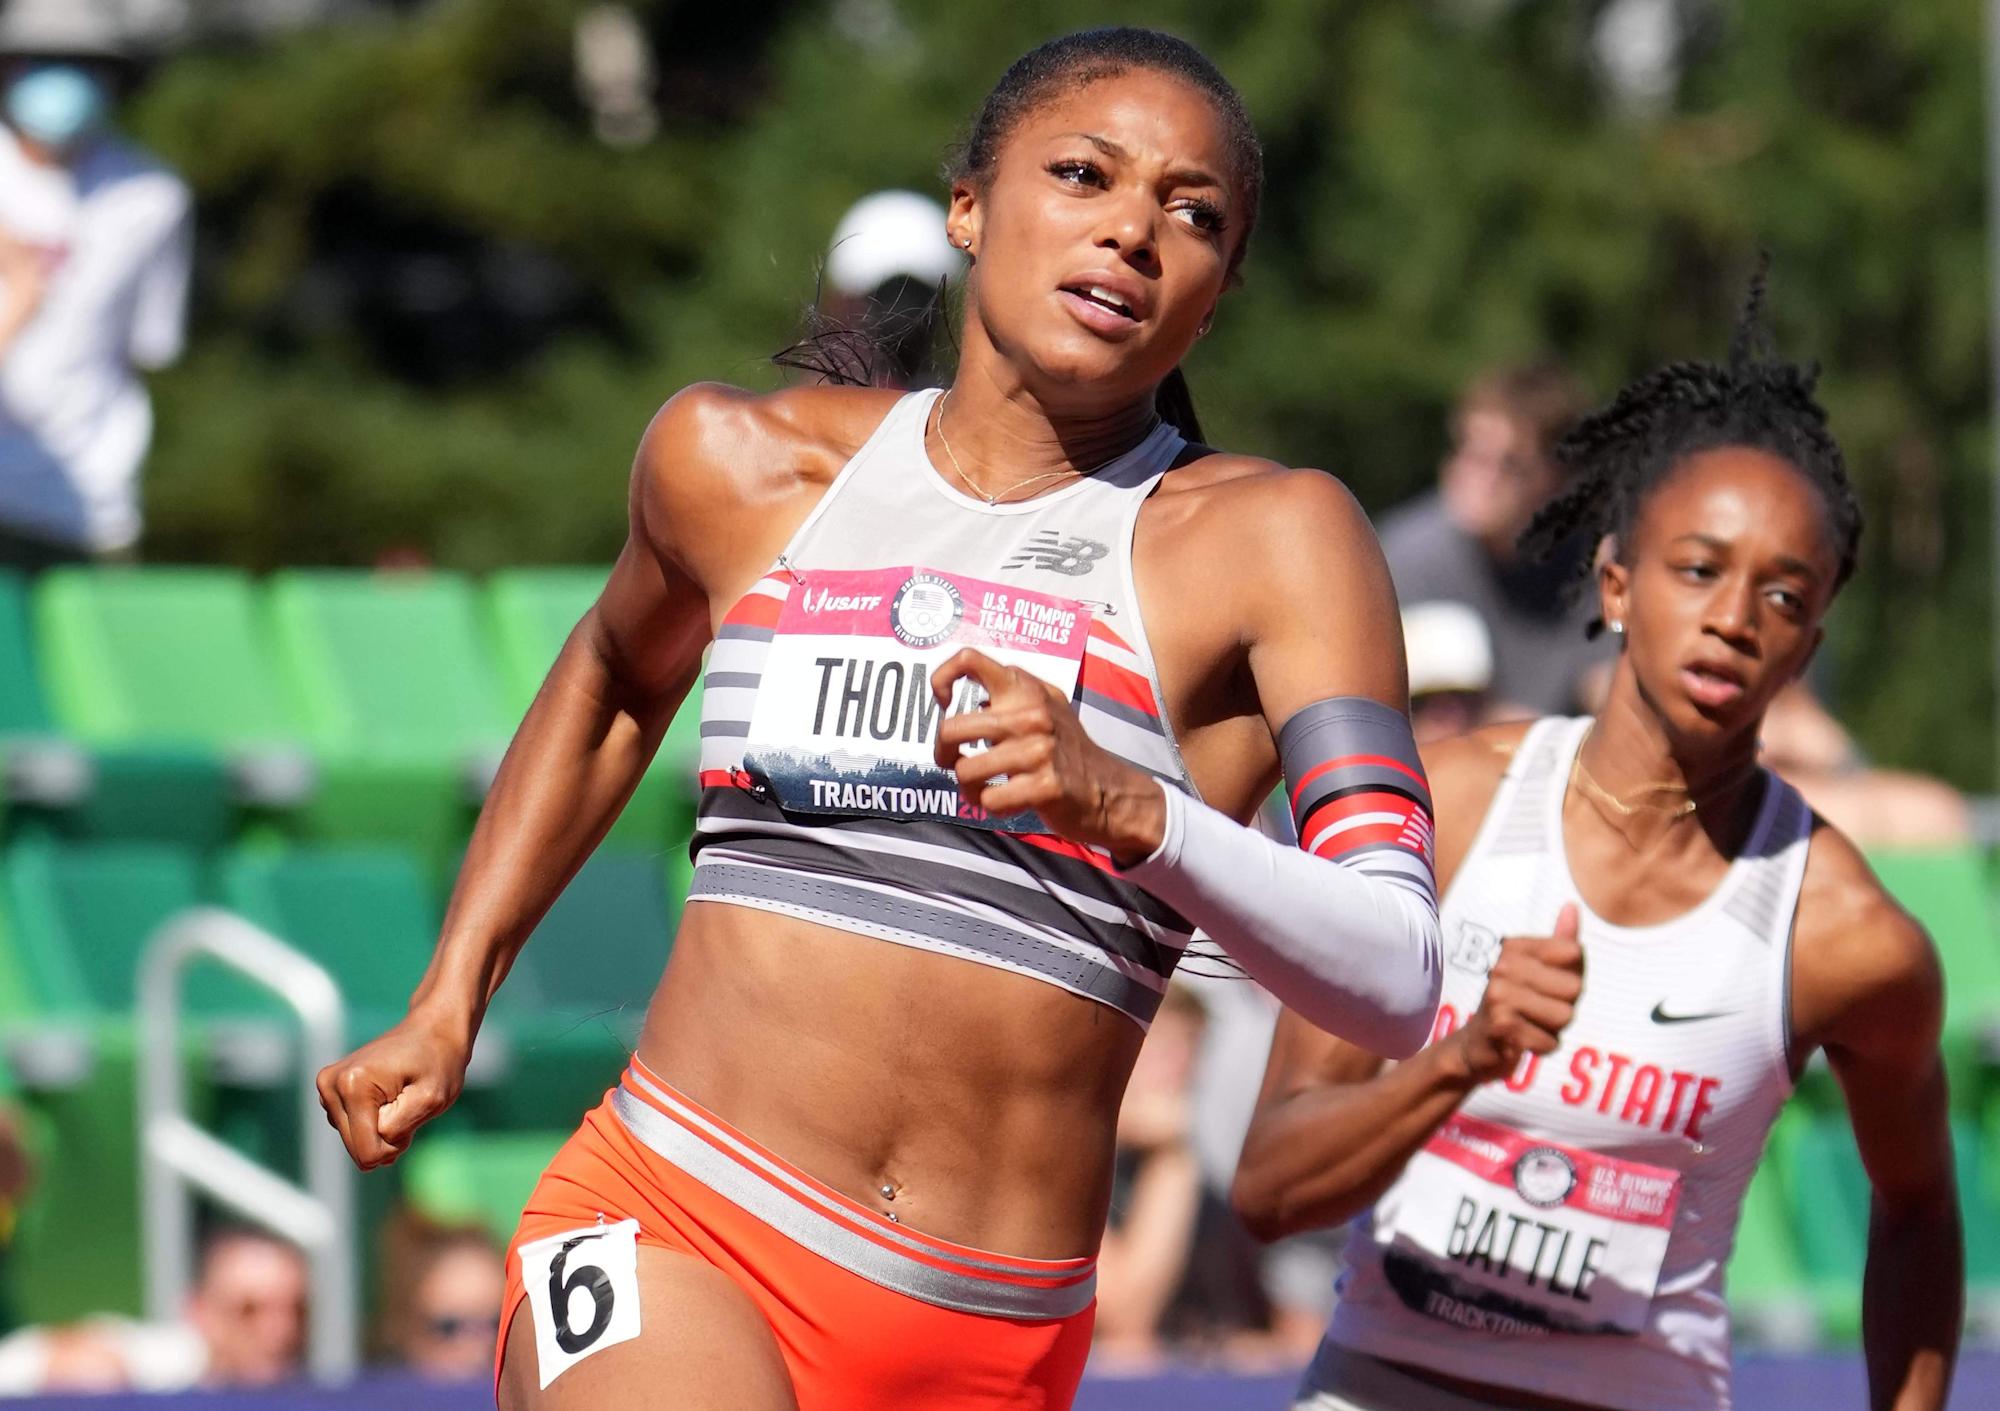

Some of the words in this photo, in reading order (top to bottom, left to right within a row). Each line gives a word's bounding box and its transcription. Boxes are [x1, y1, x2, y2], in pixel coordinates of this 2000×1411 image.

[825, 596, 882, 612] USATF
[979, 610, 1019, 634] TEAM
[1021, 619, 1071, 645] TRIALS
[982, 592, 1010, 613] U.S.
[1013, 598, 1076, 629] OLYMPIC
[812, 657, 992, 750] THOMA
[1432, 1004, 1541, 1093] OO
[1560, 1046, 1722, 1141] STATE
[549, 1232, 615, 1355] 6
[1446, 1195, 1609, 1303] BATTLE
